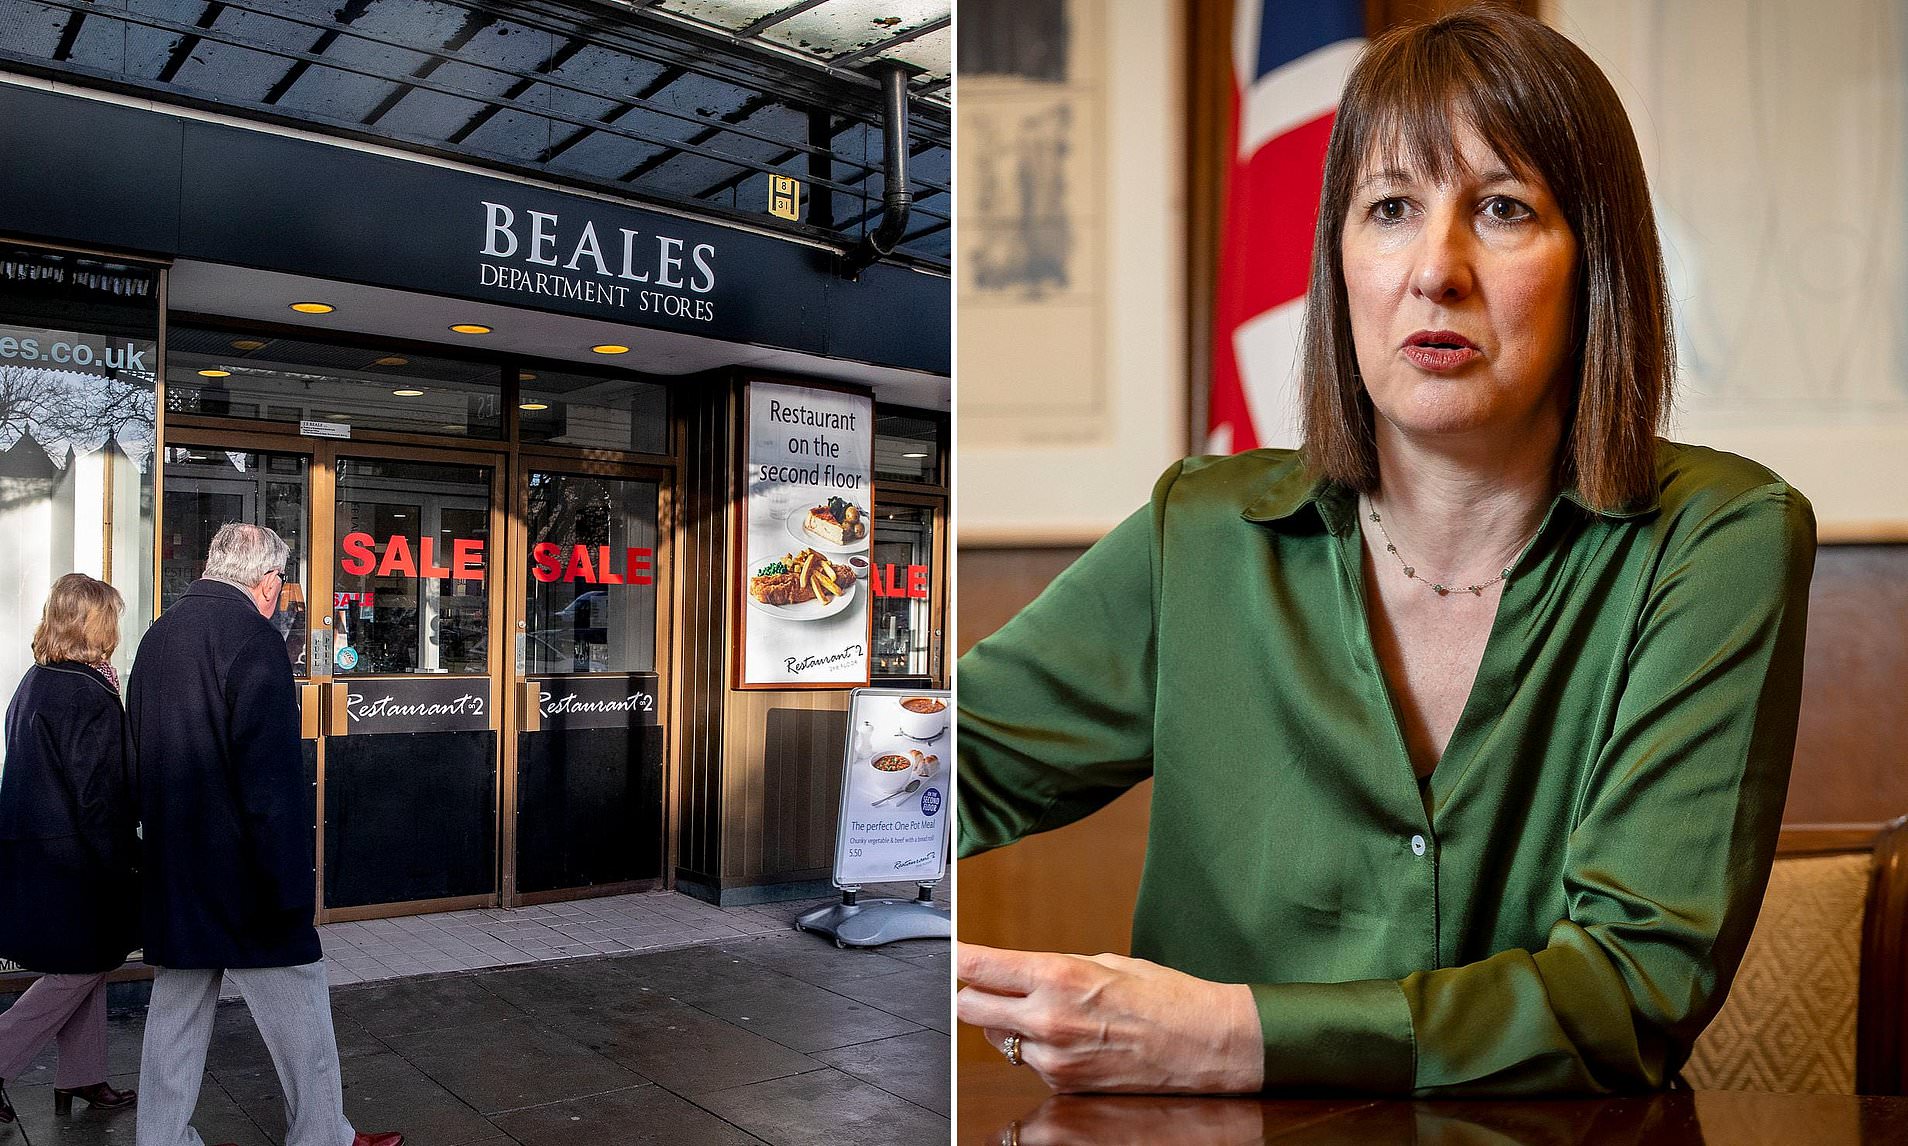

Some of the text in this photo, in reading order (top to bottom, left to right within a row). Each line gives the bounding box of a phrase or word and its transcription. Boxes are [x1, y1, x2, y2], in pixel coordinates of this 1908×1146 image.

[781, 181, 787, 190] 8
[778, 200, 788, 210] 31
[479, 200, 716, 293] BEALES
[479, 263, 714, 322] DEPARTMENT STORES
[0, 335, 146, 371] es.co.uk
[770, 399, 856, 431] Restaurant
[788, 434, 839, 458] on the
[759, 463, 862, 489] second floor
[341, 532, 484, 580] SALE
[531, 542, 653, 585] SALE
[871, 562, 928, 598] ALE
[784, 644, 863, 674] Restaurant 2
[347, 693, 472, 722] Restaurant
[472, 697, 484, 715] 2
[540, 691, 643, 718] Restaurant
[643, 694, 653, 711] 2
[852, 819, 936, 833] The perfect One Pot Meal
[849, 848, 862, 857] 5.50
